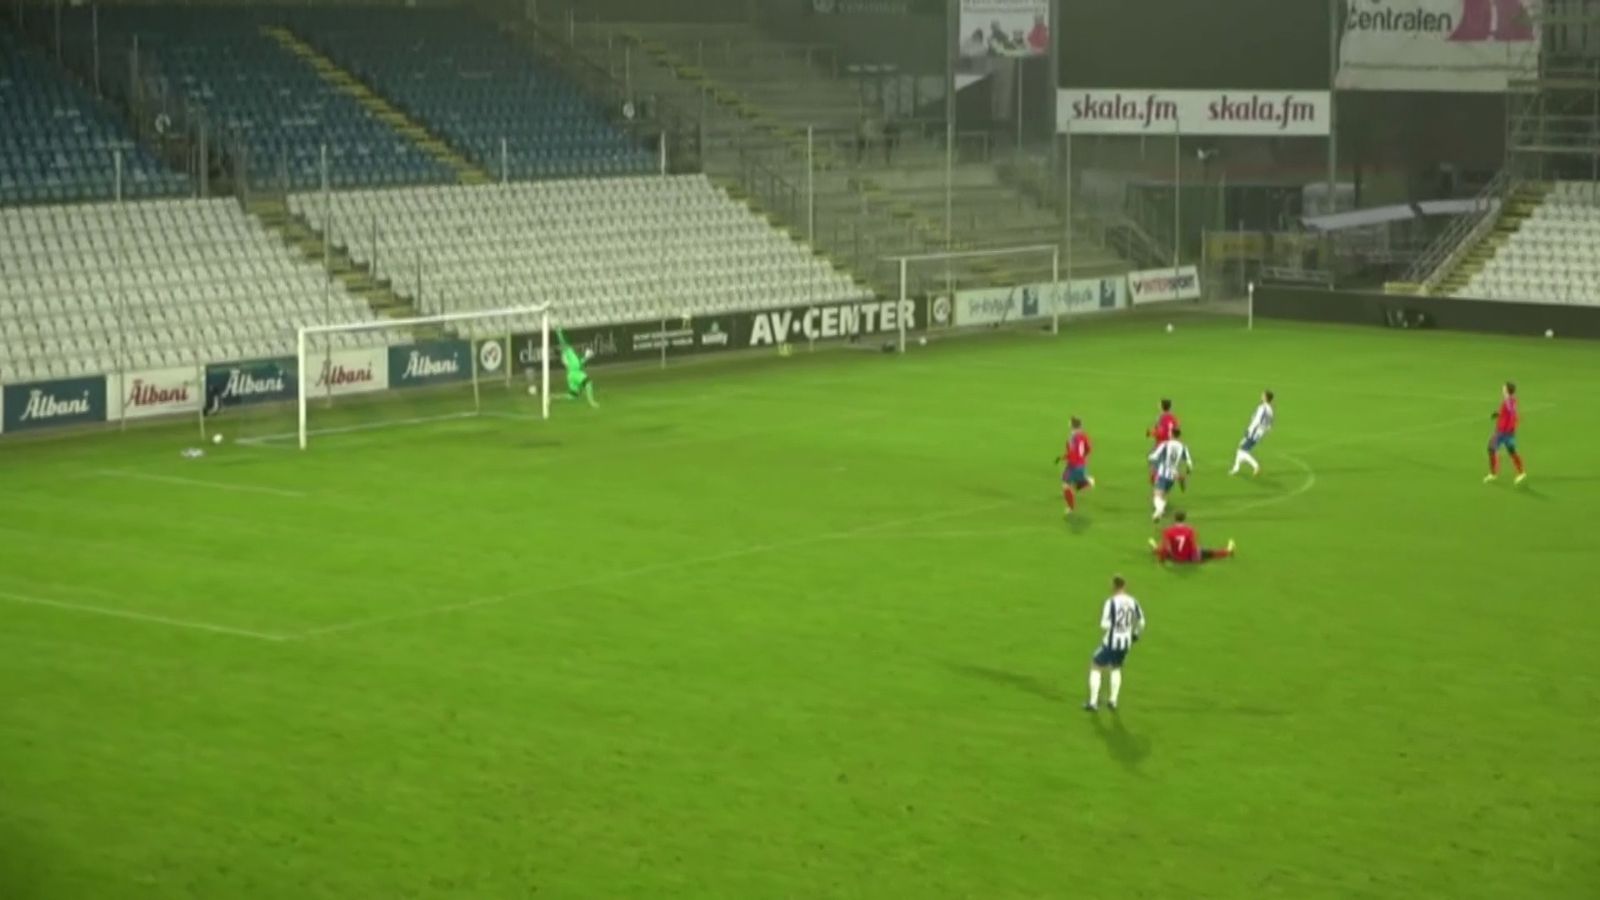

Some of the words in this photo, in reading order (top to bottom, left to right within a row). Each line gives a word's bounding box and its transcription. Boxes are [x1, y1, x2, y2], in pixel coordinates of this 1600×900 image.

[1072, 93, 1178, 128] skala.fm
[1207, 94, 1314, 129] skala.fm
[1175, 535, 1185, 551] 7
[1116, 607, 1134, 633] 20
